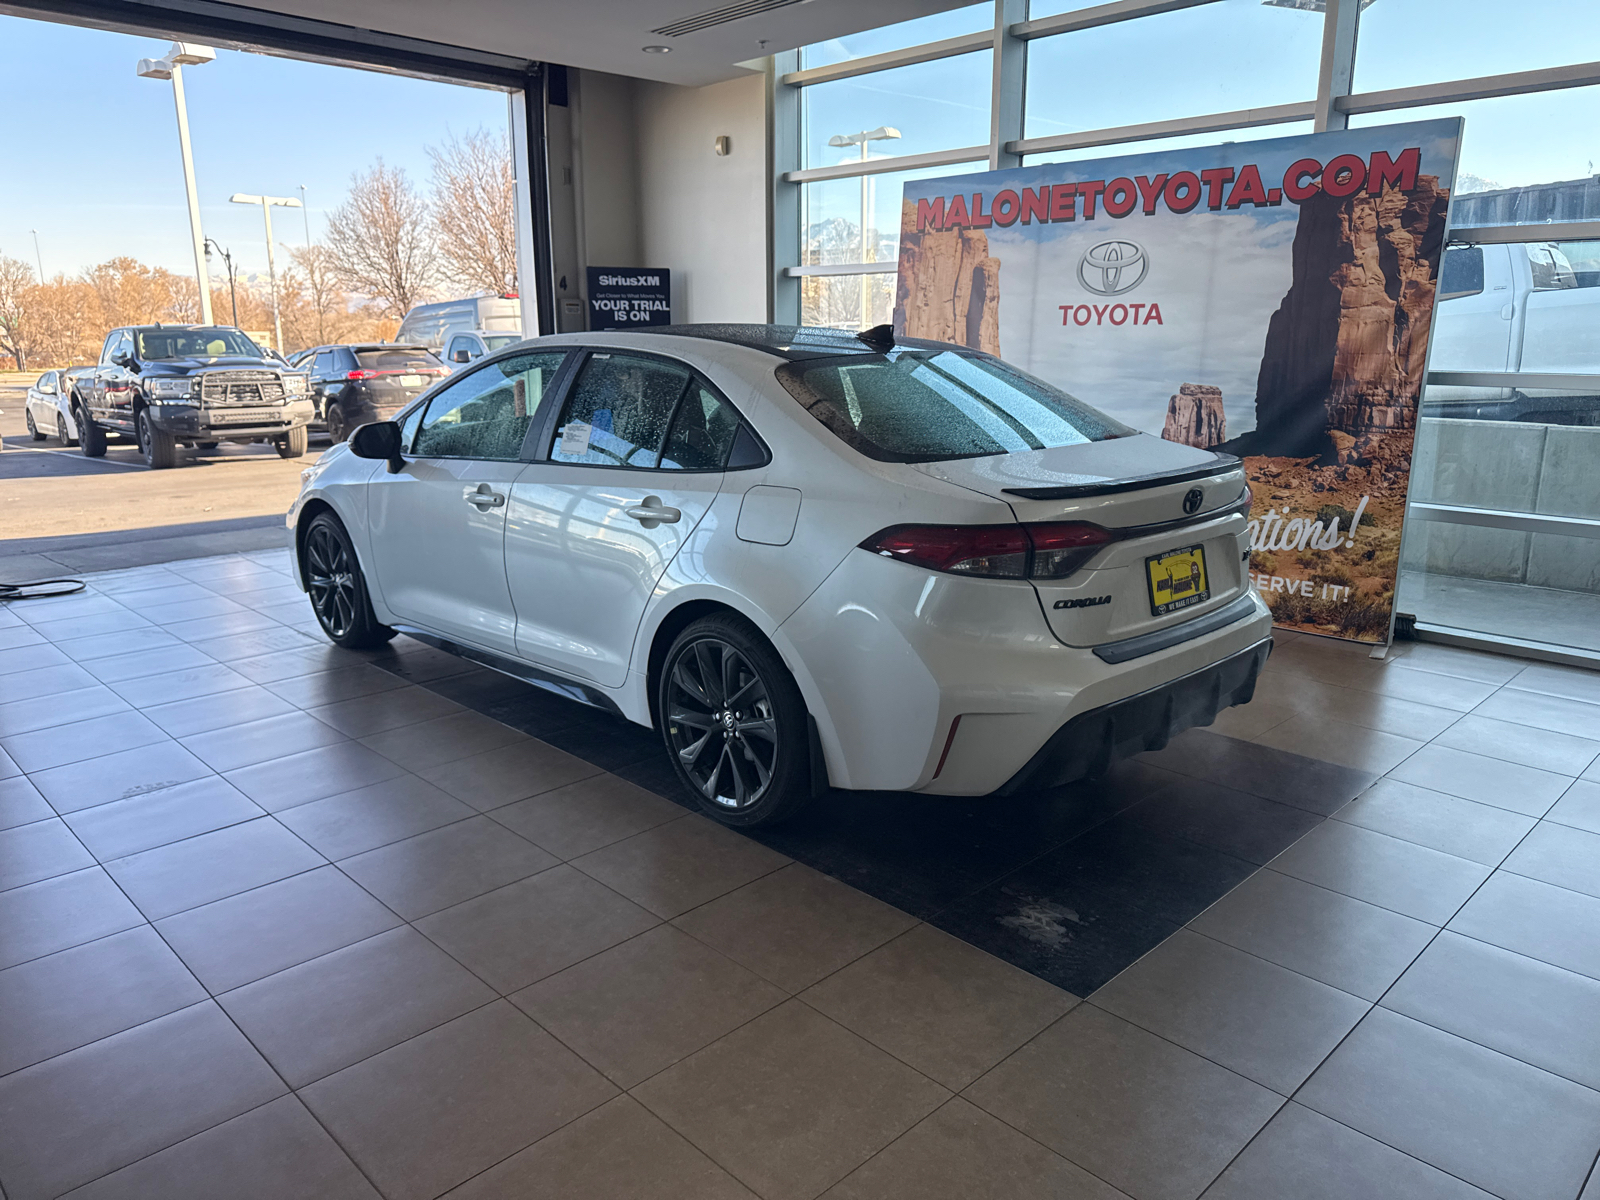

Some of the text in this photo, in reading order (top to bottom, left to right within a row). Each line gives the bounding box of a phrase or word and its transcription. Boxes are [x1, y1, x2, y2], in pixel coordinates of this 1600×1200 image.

[917, 147, 1421, 232] MALONETOYOTA.COM
[559, 275, 568, 291] 4
[598, 275, 660, 287] SiriusXM
[591, 299, 630, 311] YOUR
[631, 300, 670, 311] TRIAL
[614, 310, 650, 321] IS ON
[1058, 302, 1164, 327] TOYOTA
[1321, 584, 1350, 603] IT!
[1053, 594, 1112, 610] COROLLA
[1175, 600, 1186, 609] MAKE
[1190, 595, 1199, 604] EASY
